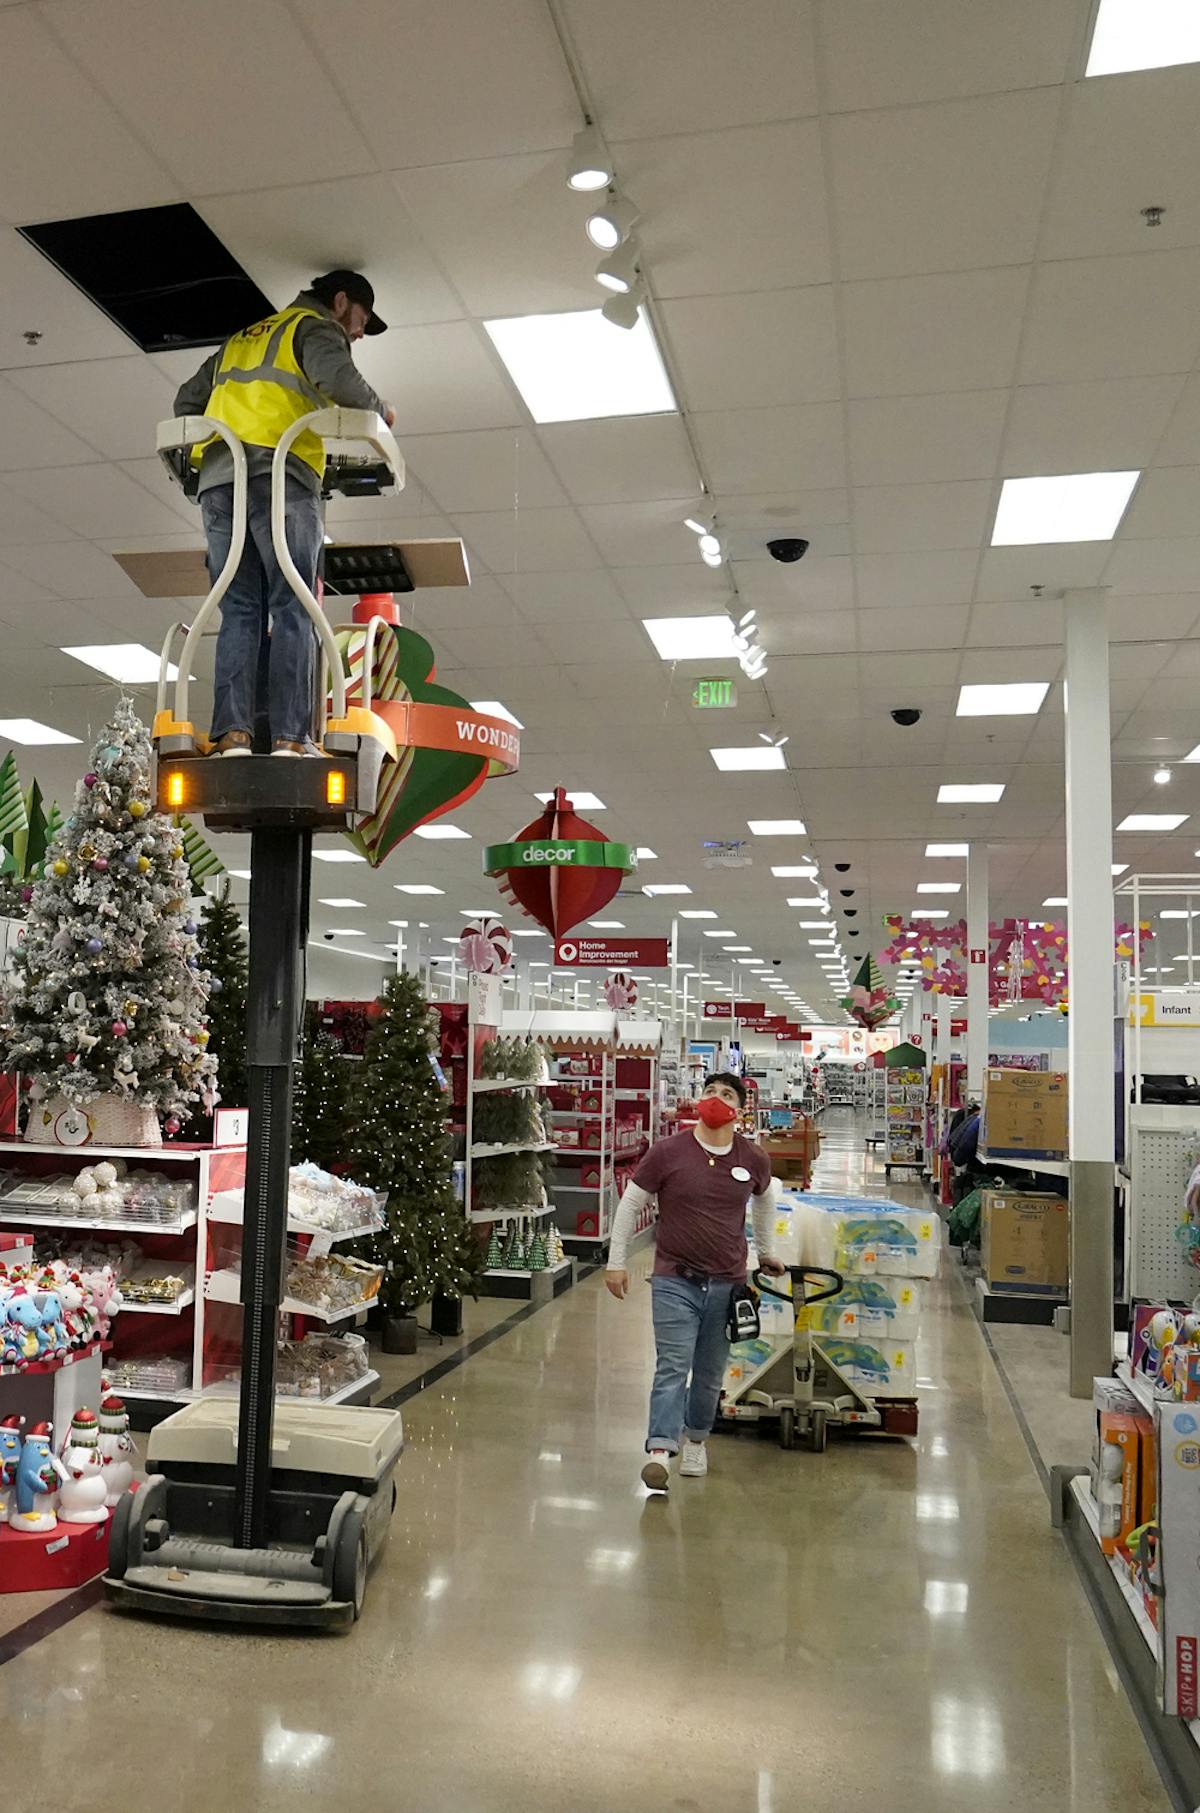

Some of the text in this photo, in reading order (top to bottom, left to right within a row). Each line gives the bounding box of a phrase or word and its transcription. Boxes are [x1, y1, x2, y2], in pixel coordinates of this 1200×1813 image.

[699, 681, 732, 705] EXIT
[523, 846, 576, 862] decor
[579, 941, 606, 950] Home
[579, 950, 640, 959] Improvement
[1162, 1006, 1191, 1014] Infant
[1180, 1640, 1193, 1713] SKIP HOP
